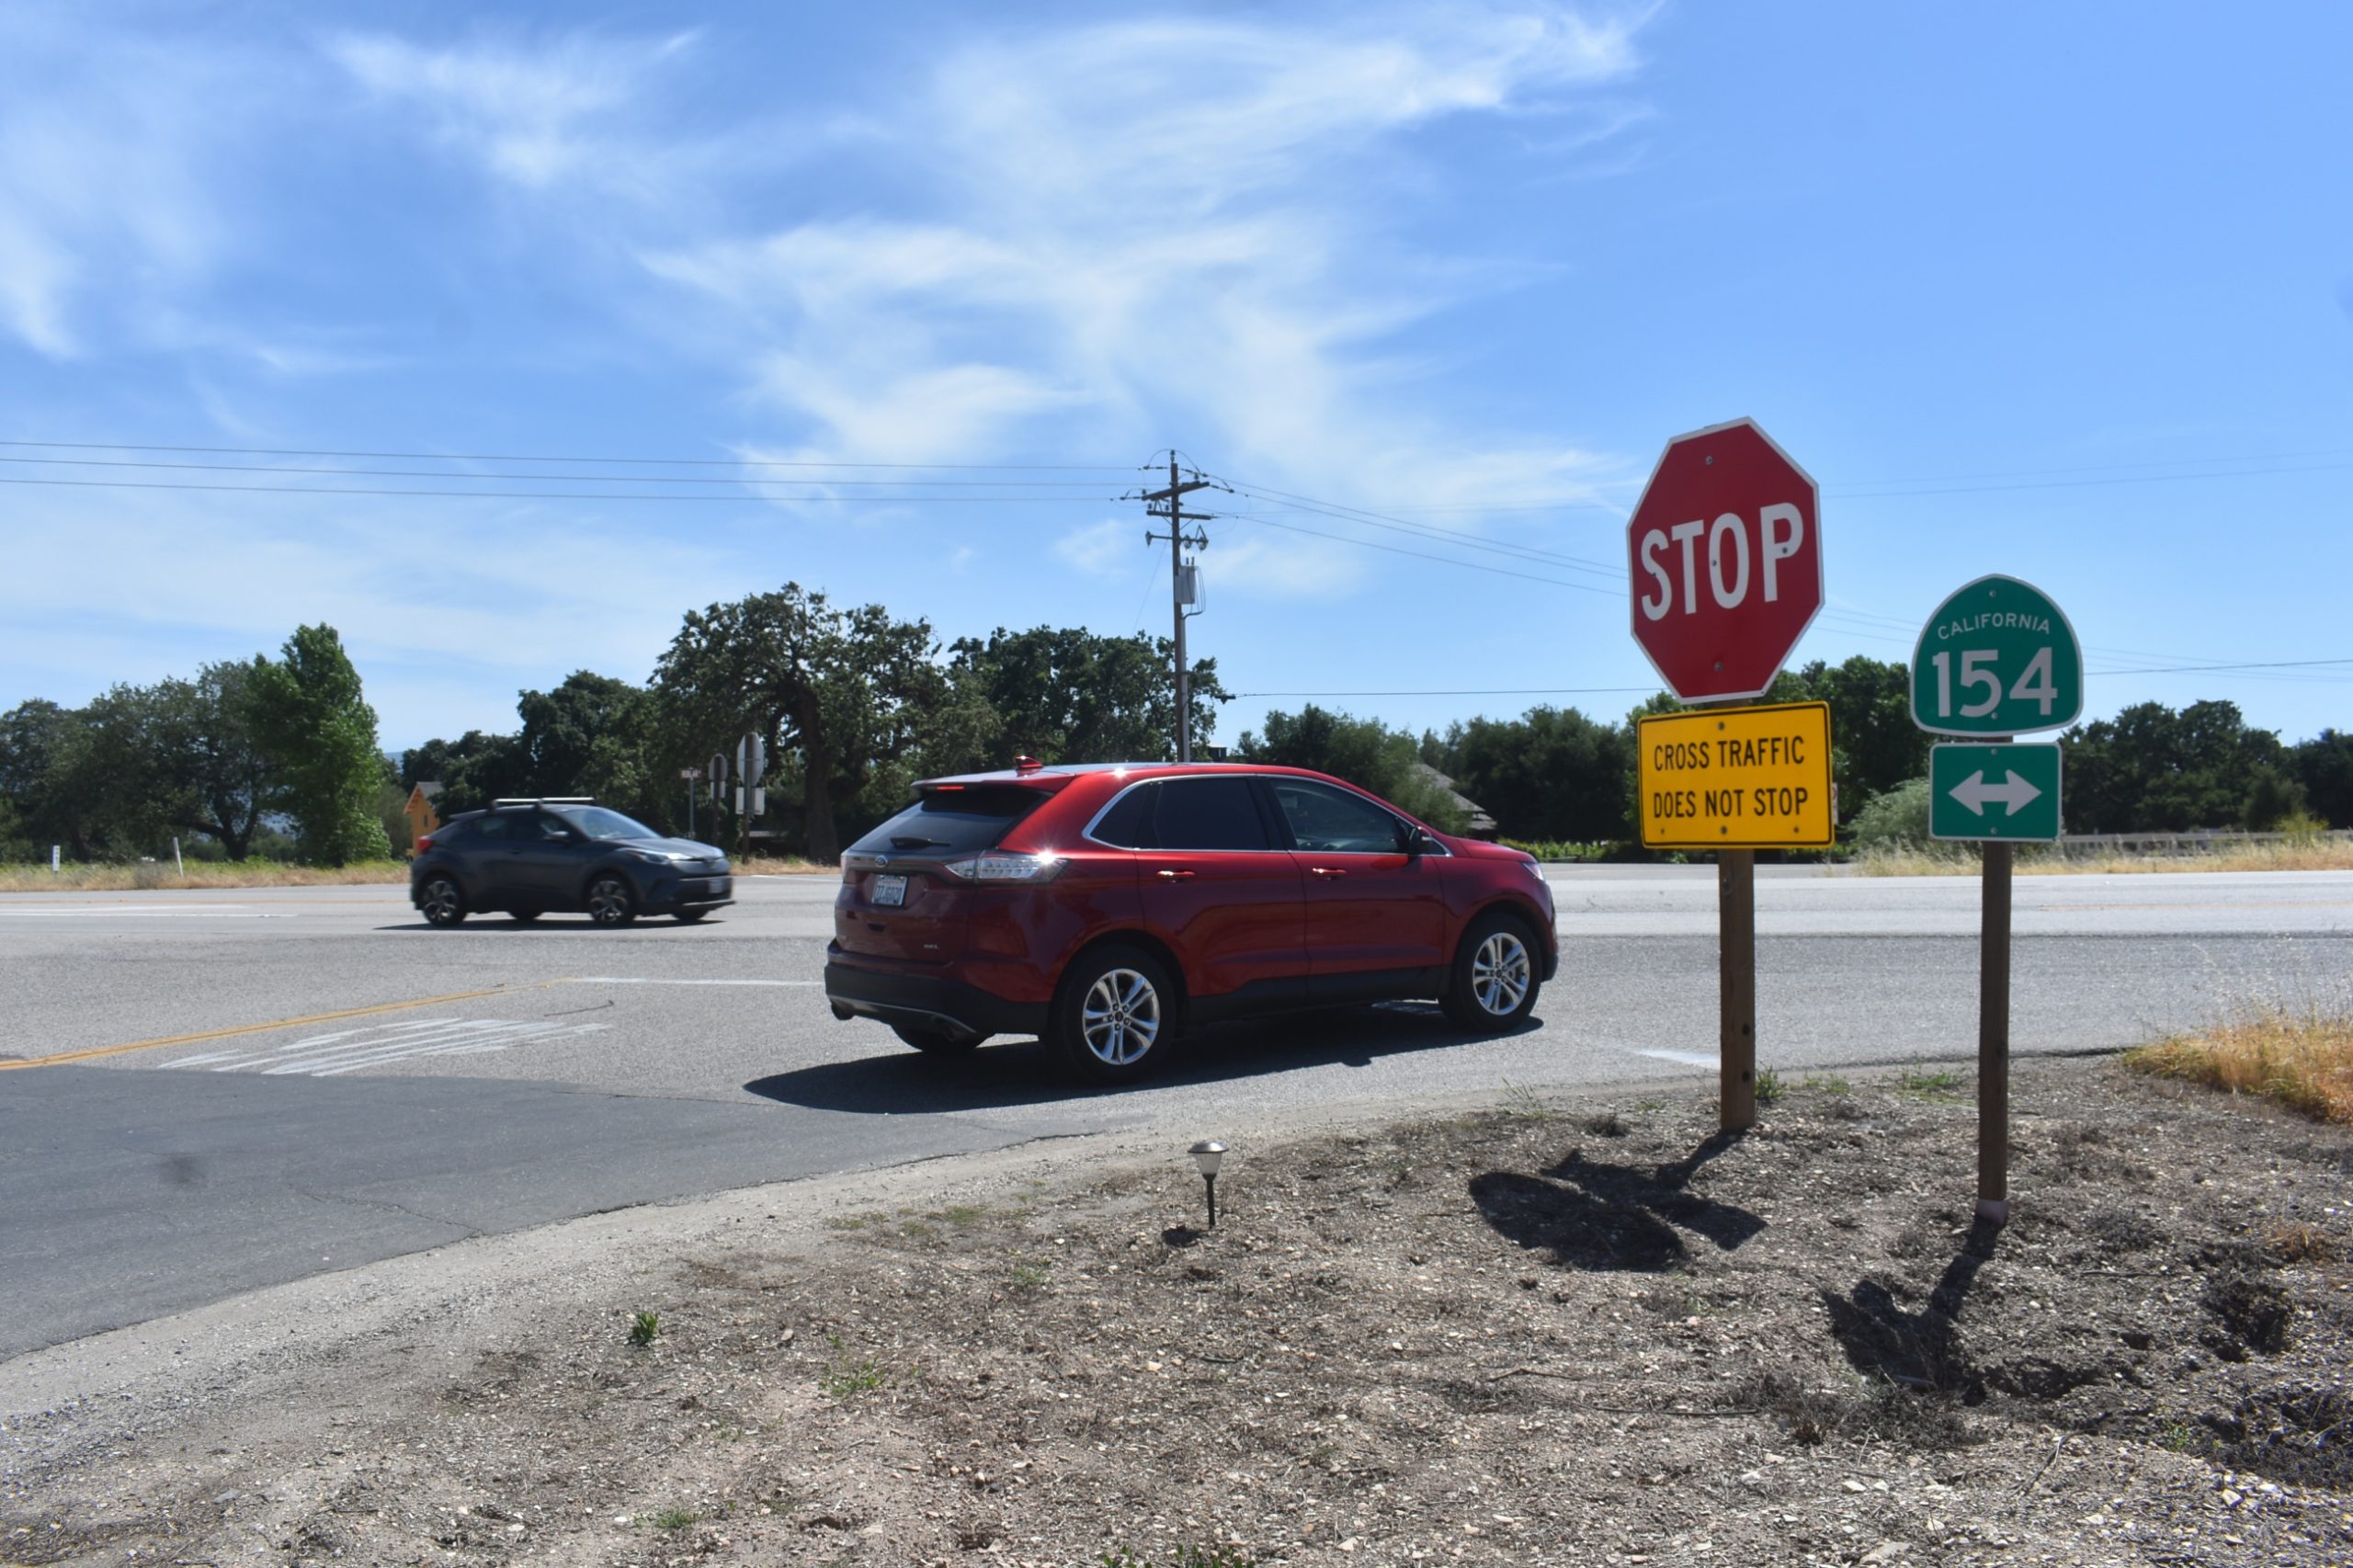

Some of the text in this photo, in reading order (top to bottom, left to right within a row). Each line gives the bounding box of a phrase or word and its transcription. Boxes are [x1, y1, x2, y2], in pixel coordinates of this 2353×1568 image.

[1642, 503, 1803, 620] STOP
[1938, 613, 2051, 640] CALIFORNIA
[1931, 647, 2059, 718] 154
[1654, 736, 1804, 771] CROSS TRAFFIC
[1654, 787, 1808, 818] DOES NOT STOP
